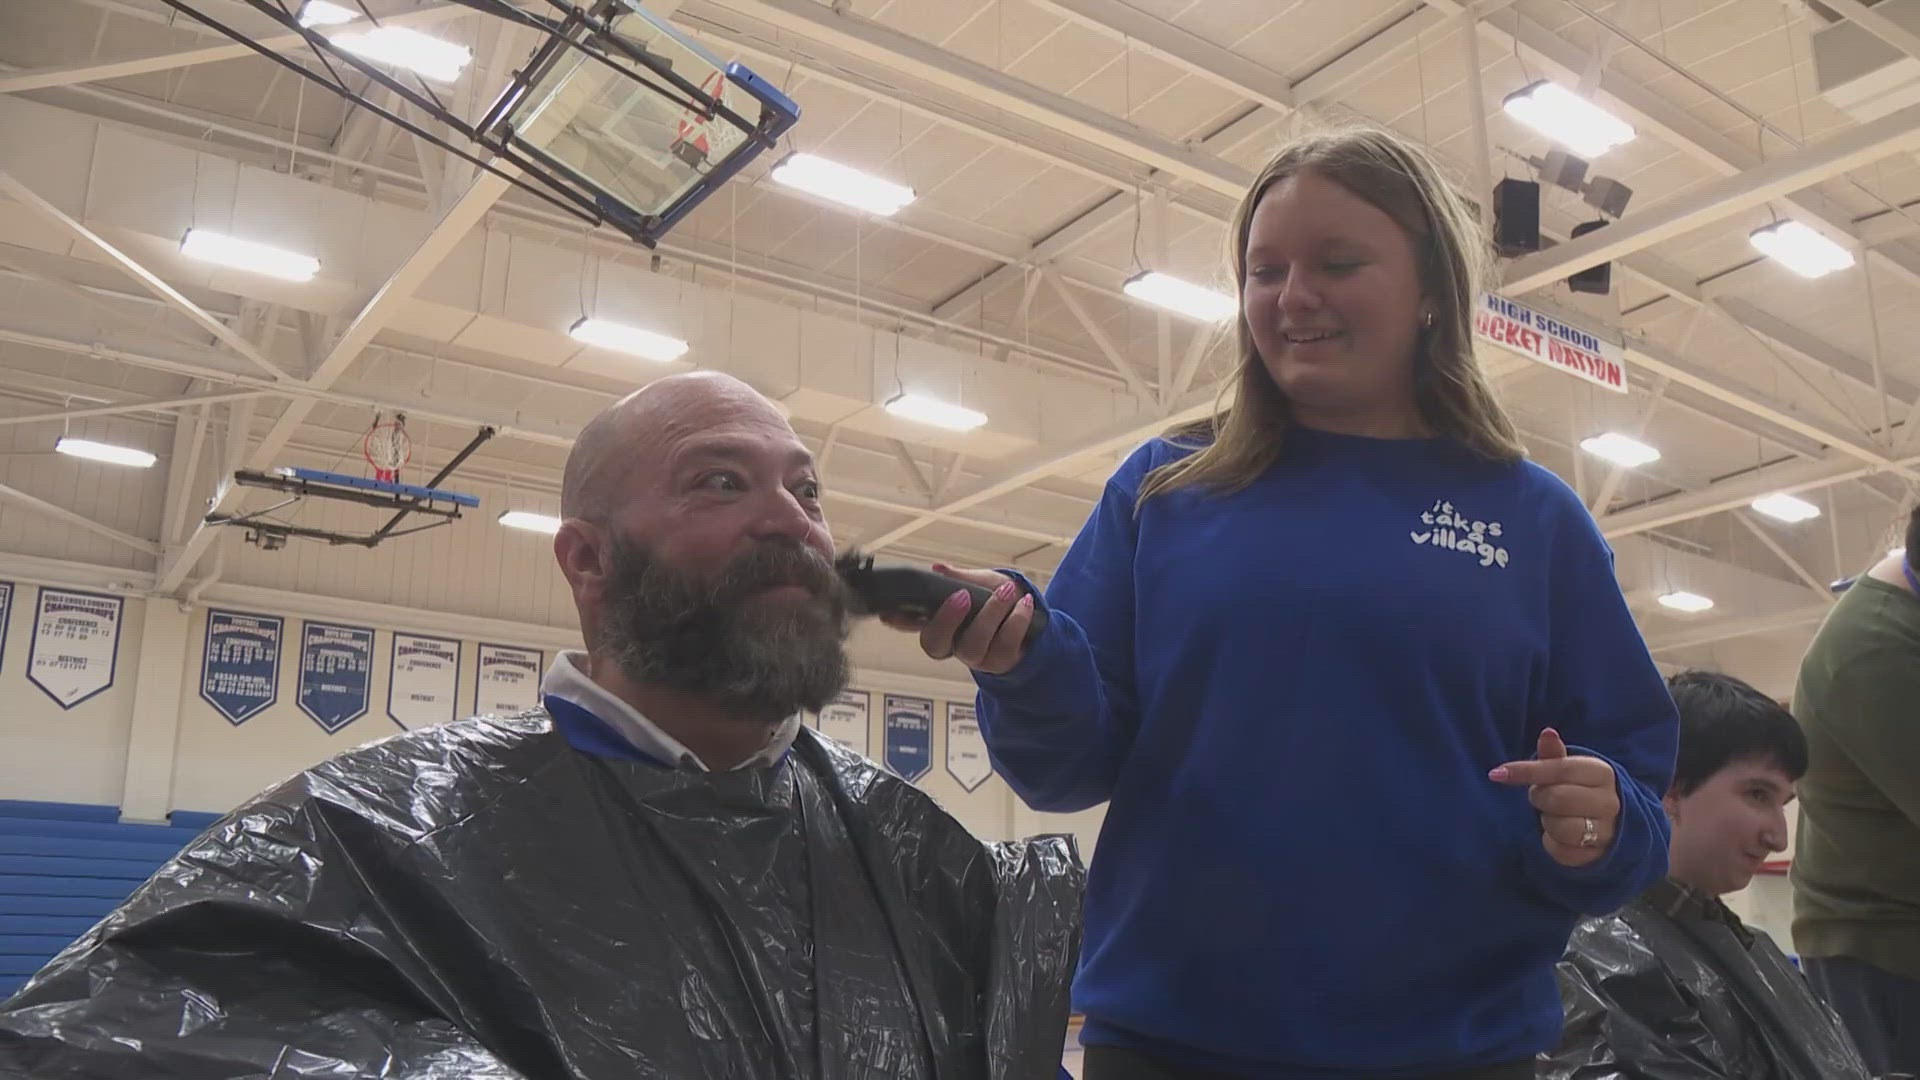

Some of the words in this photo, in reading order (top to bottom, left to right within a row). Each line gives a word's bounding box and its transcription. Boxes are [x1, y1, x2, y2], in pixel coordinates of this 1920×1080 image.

[1487, 294, 1531, 325] HIGH
[1536, 314, 1601, 354] SCHOOL
[1476, 311, 1543, 356] OCKET
[1548, 337, 1621, 387] NATION
[1433, 499, 1454, 515] it
[1420, 510, 1502, 537] takes
[1467, 532, 1484, 544] a
[1410, 528, 1509, 569] village
[44, 594, 64, 603] GIRLS
[64, 597, 86, 606] CROSS
[87, 599, 117, 609] COUNTRY
[44, 602, 115, 622] CHAMPIONSHIPS
[58, 617, 98, 628] CONFERENCE
[231, 617, 259, 627] FOOTBALL
[213, 623, 276, 641] CHAMPIONSHIPS
[226, 637, 261, 647] CONFERENCE
[308, 635, 367, 652] CHAMPIONSHIPS
[58, 655, 88, 664] DISTRICT
[398, 645, 454, 663] CHAMPIONSHIPS
[409, 659, 441, 669] CONFERENCE
[483, 656, 537, 673] CHAMPIONSHIPS
[411, 694, 435, 702] DISTRICT
